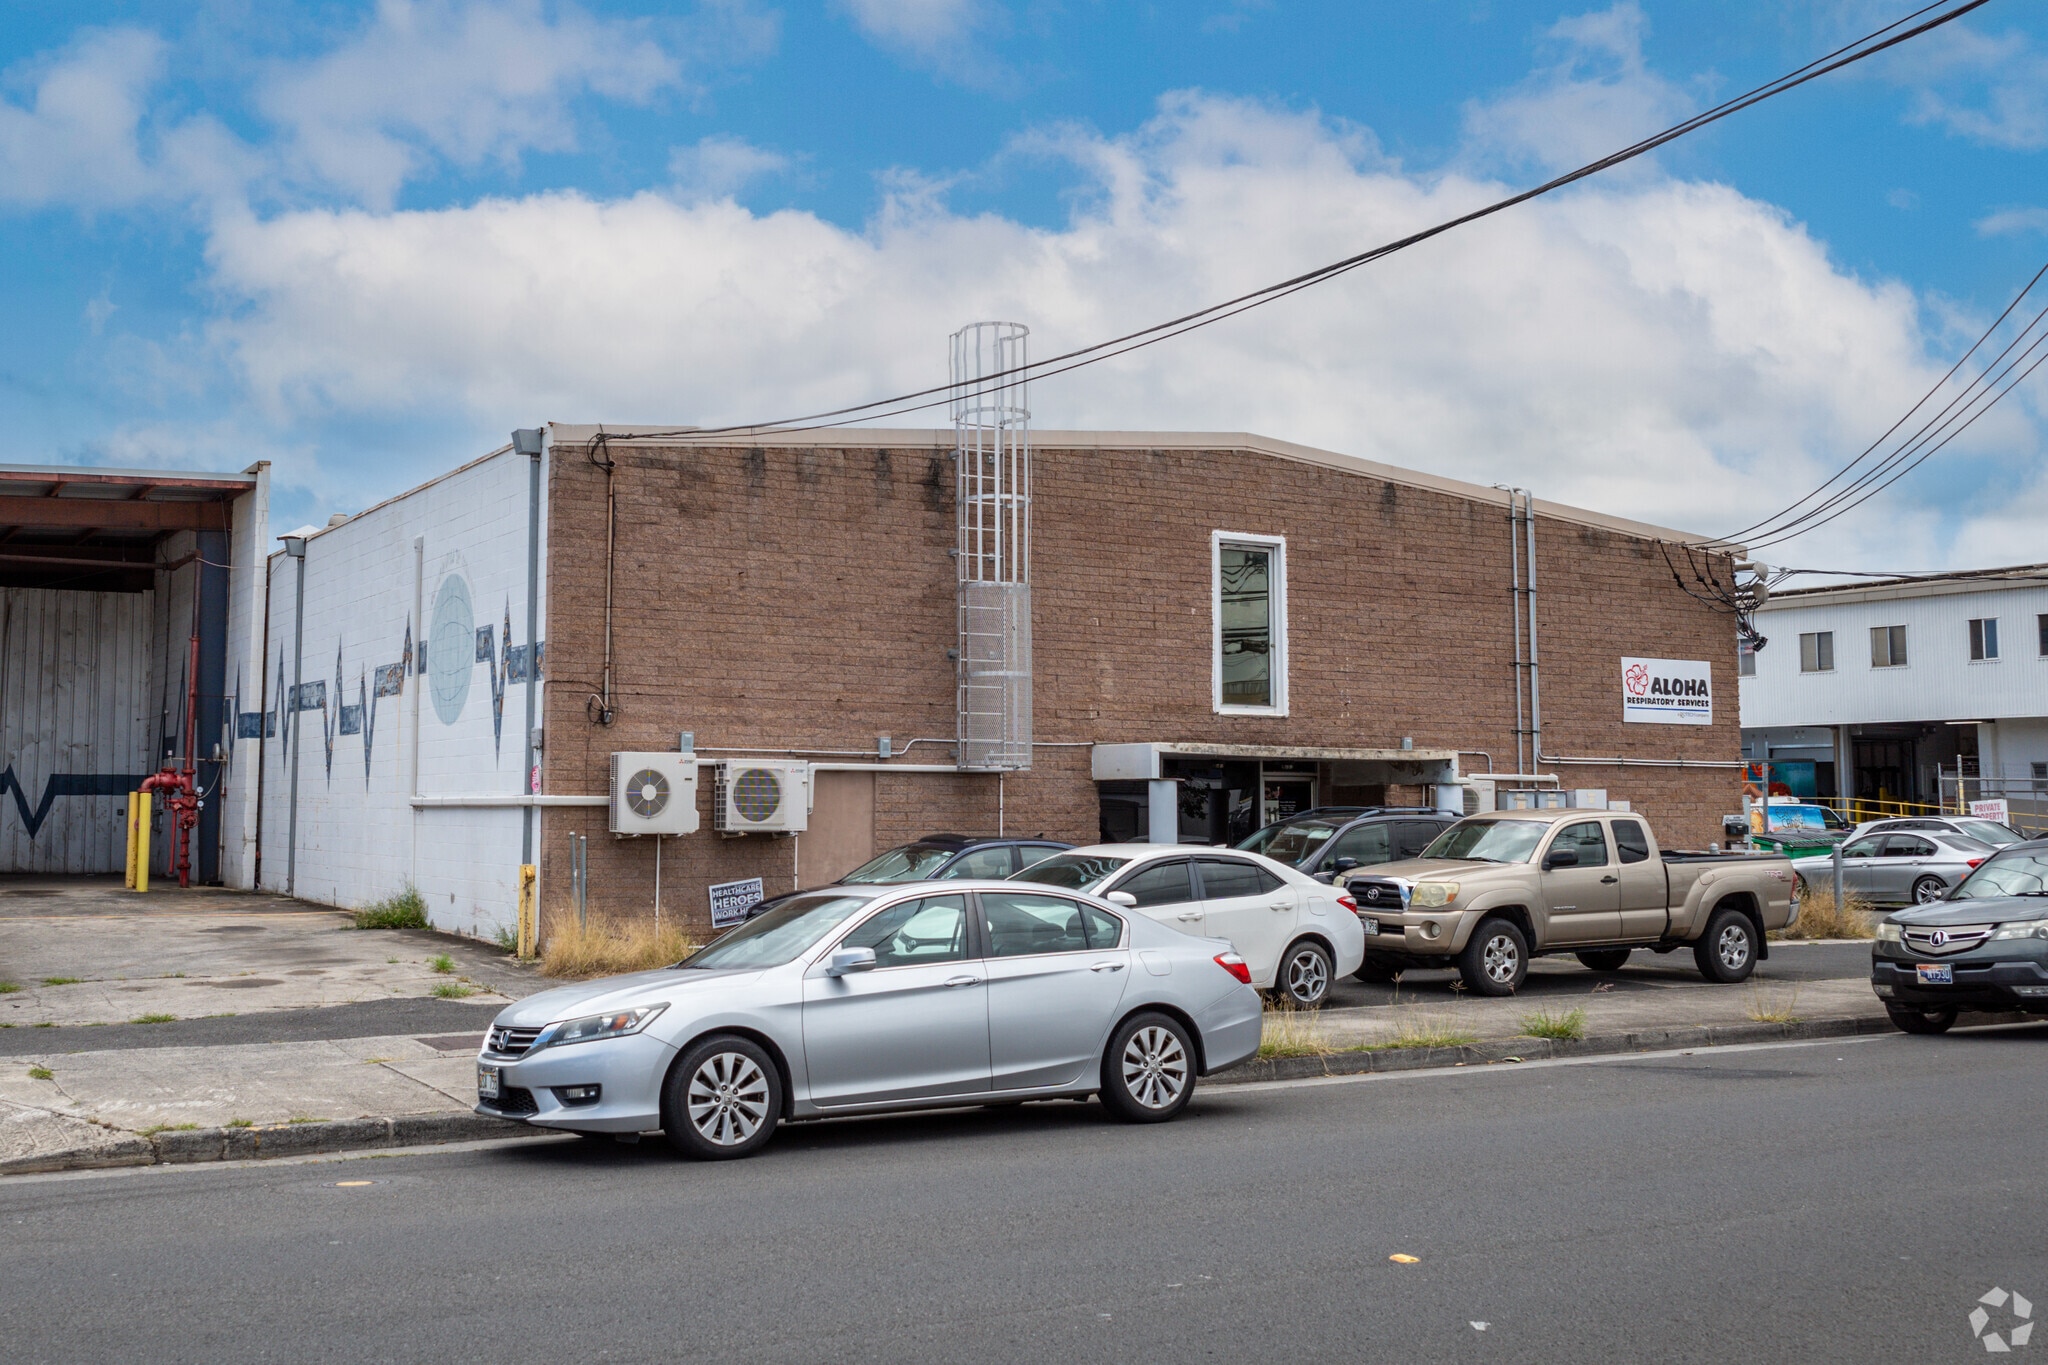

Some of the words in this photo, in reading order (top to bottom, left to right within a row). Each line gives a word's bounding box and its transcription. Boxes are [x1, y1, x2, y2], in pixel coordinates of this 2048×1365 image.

[1651, 677, 1709, 697] ALOHA
[1627, 697, 1675, 706] RESPIRATORY
[1678, 699, 1710, 707] SERVICES
[1975, 803, 2001, 812] PRIVATE
[712, 884, 760, 898] HEALTHCARE
[714, 893, 761, 909] HEROES
[715, 908, 739, 919] WORK
